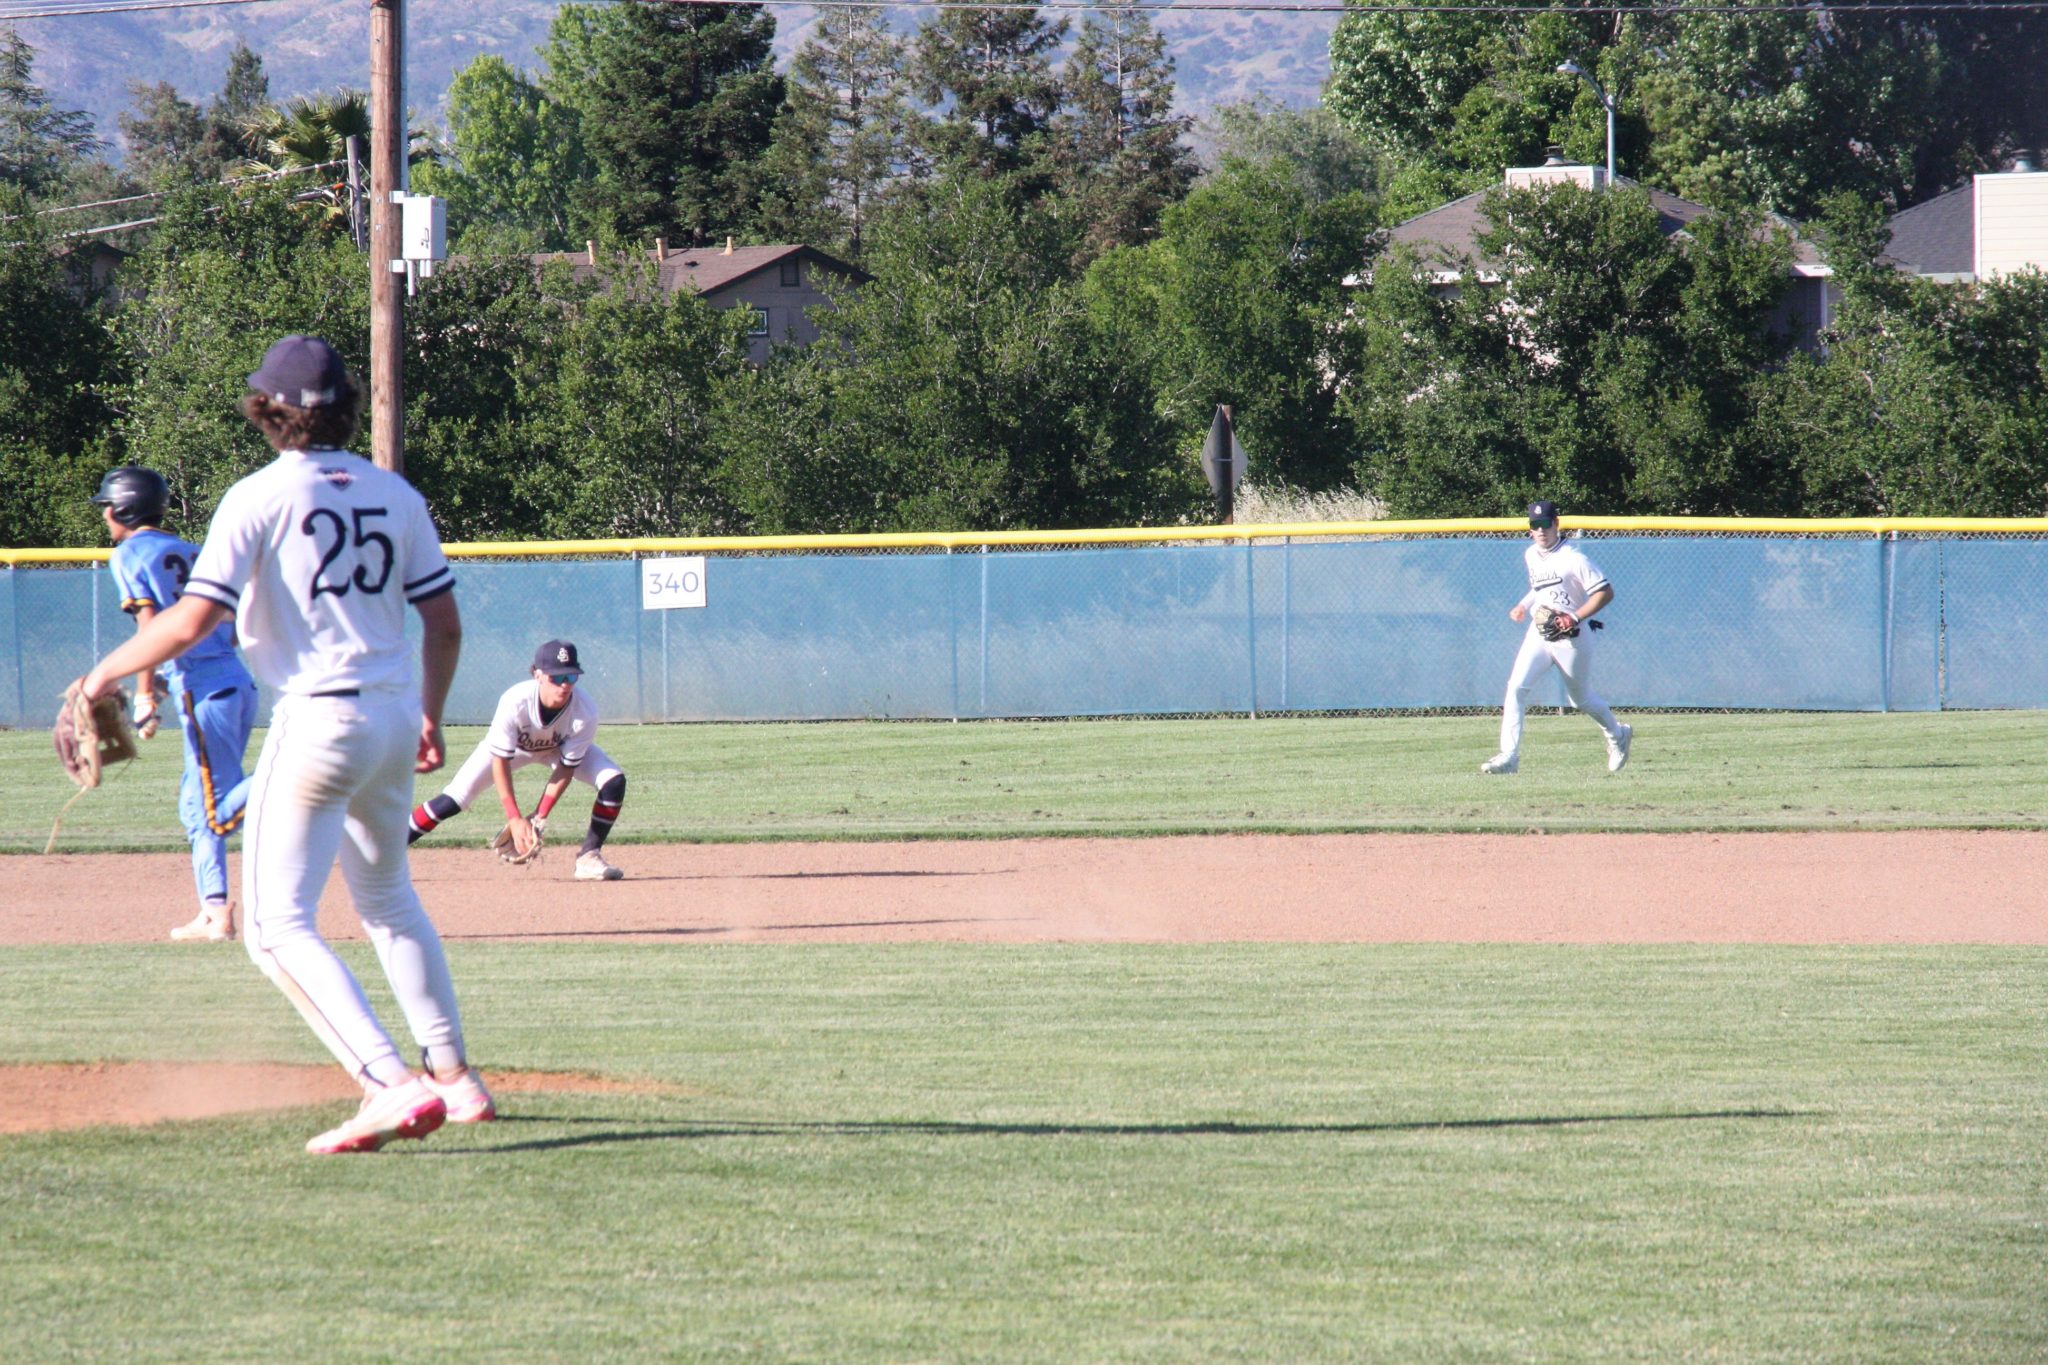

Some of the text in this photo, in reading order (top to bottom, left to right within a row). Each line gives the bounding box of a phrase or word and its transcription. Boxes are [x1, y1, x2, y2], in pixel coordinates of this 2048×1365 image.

[302, 507, 394, 600] 25
[163, 553, 199, 601] 3
[648, 571, 699, 595] 340
[1550, 590, 1571, 606] 23
